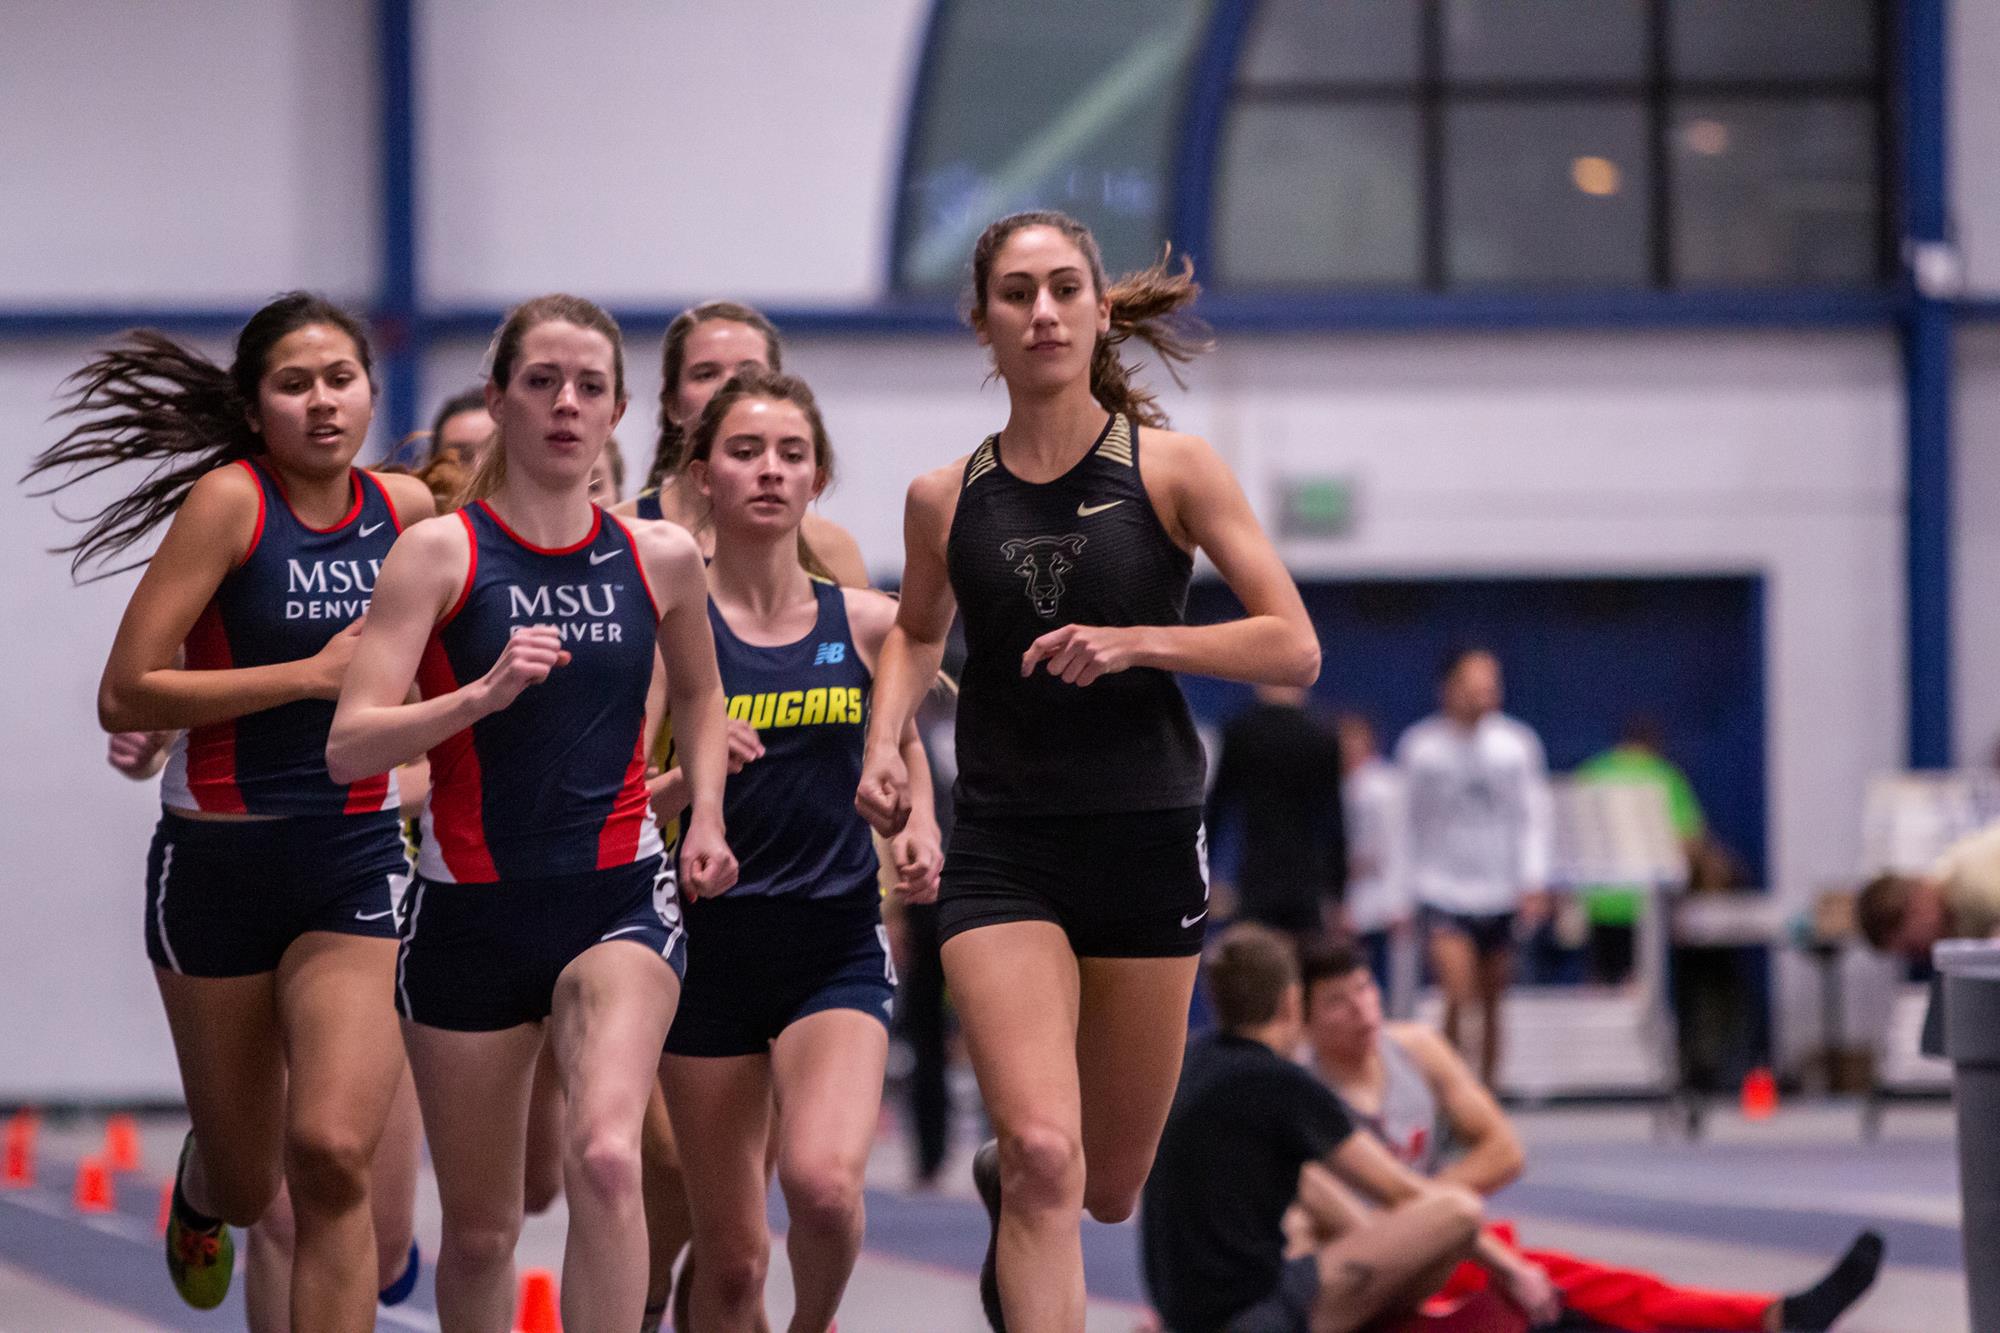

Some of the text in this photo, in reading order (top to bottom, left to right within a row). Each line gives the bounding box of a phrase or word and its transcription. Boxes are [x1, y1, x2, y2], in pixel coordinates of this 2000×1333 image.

[287, 558, 380, 594] MSU
[508, 584, 616, 618] MSU
[510, 622, 622, 642] NVER
[724, 687, 862, 729] OUGARS
